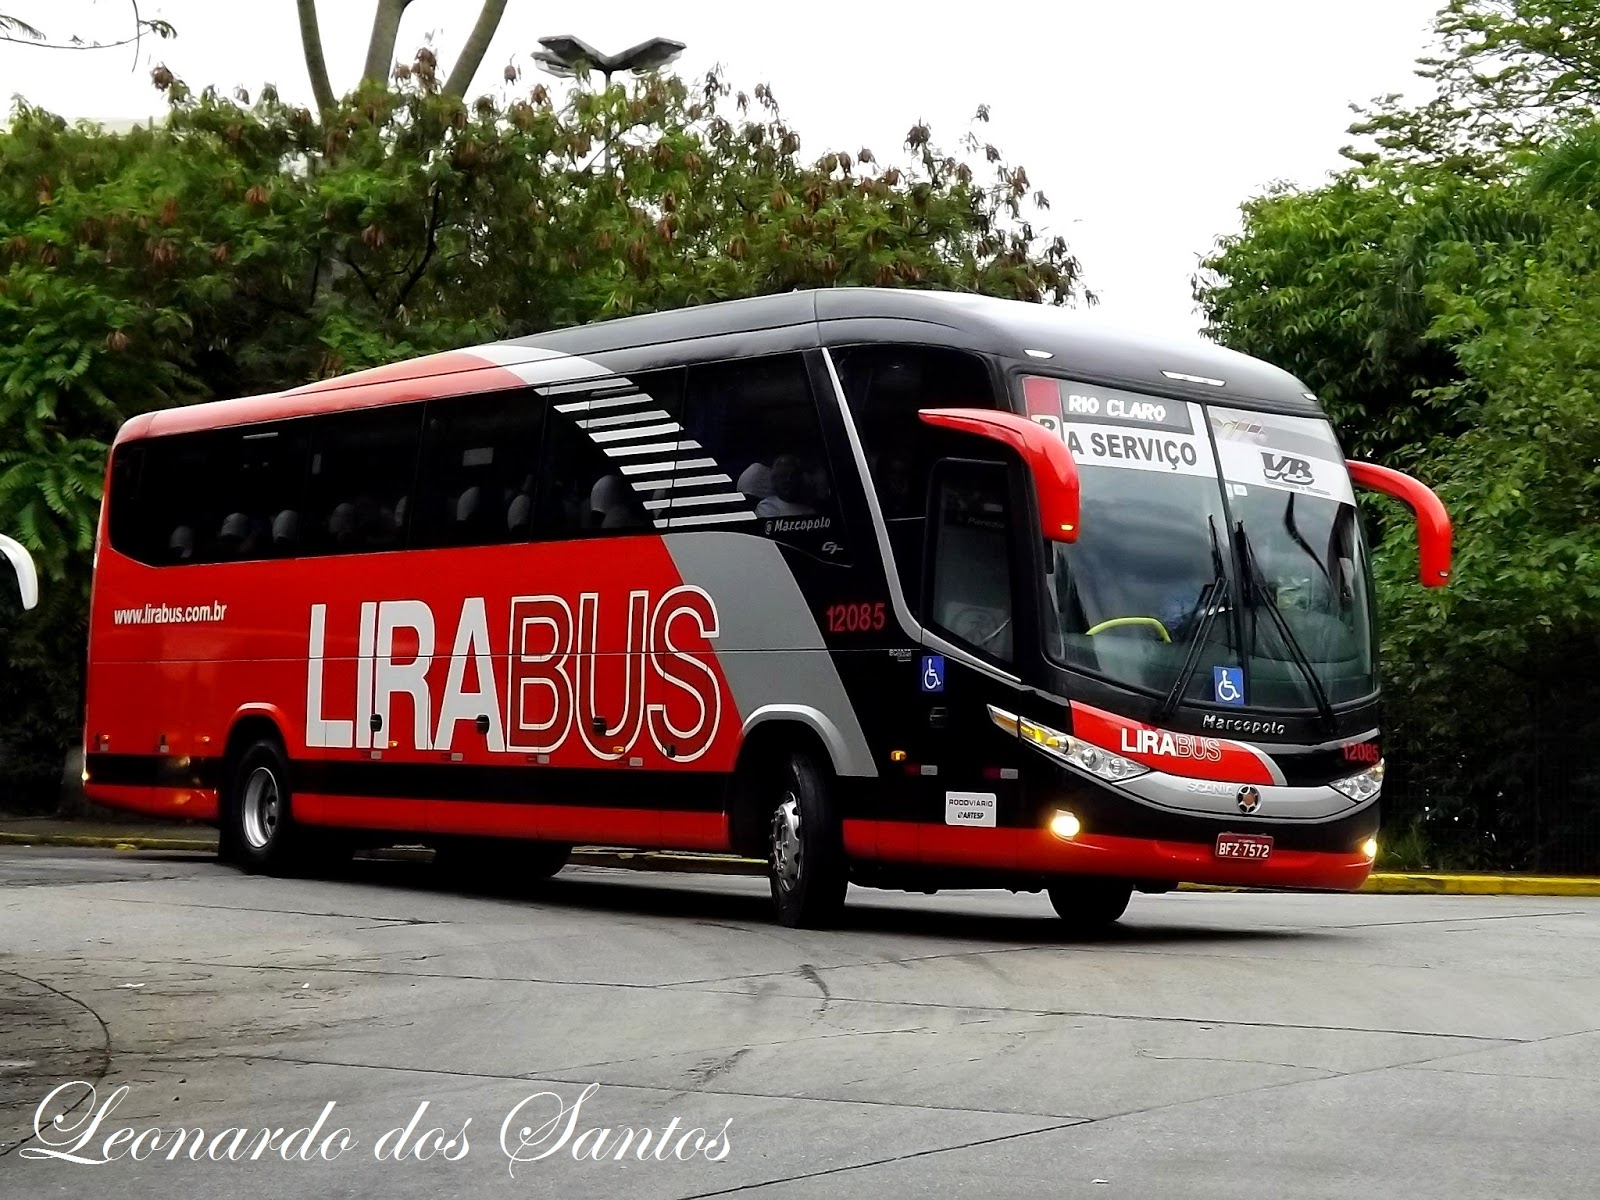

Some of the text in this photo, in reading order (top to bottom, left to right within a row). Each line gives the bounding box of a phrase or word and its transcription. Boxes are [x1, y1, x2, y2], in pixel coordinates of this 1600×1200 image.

[1068, 395, 1167, 422] RIO CLARO
[1067, 431, 1197, 470] A SERVIÇO
[1260, 452, 1315, 485] VB
[774, 516, 831, 532] Marcopolo
[114, 600, 227, 625] www.lirabus.com.br
[826, 603, 886, 632] 12085
[306, 584, 721, 762] LIRABUS
[1202, 714, 1286, 735] Marcopolo
[1121, 728, 1222, 762] LIRABUS
[1343, 742, 1380, 763] 12085
[1187, 783, 1235, 797] SCANIA
